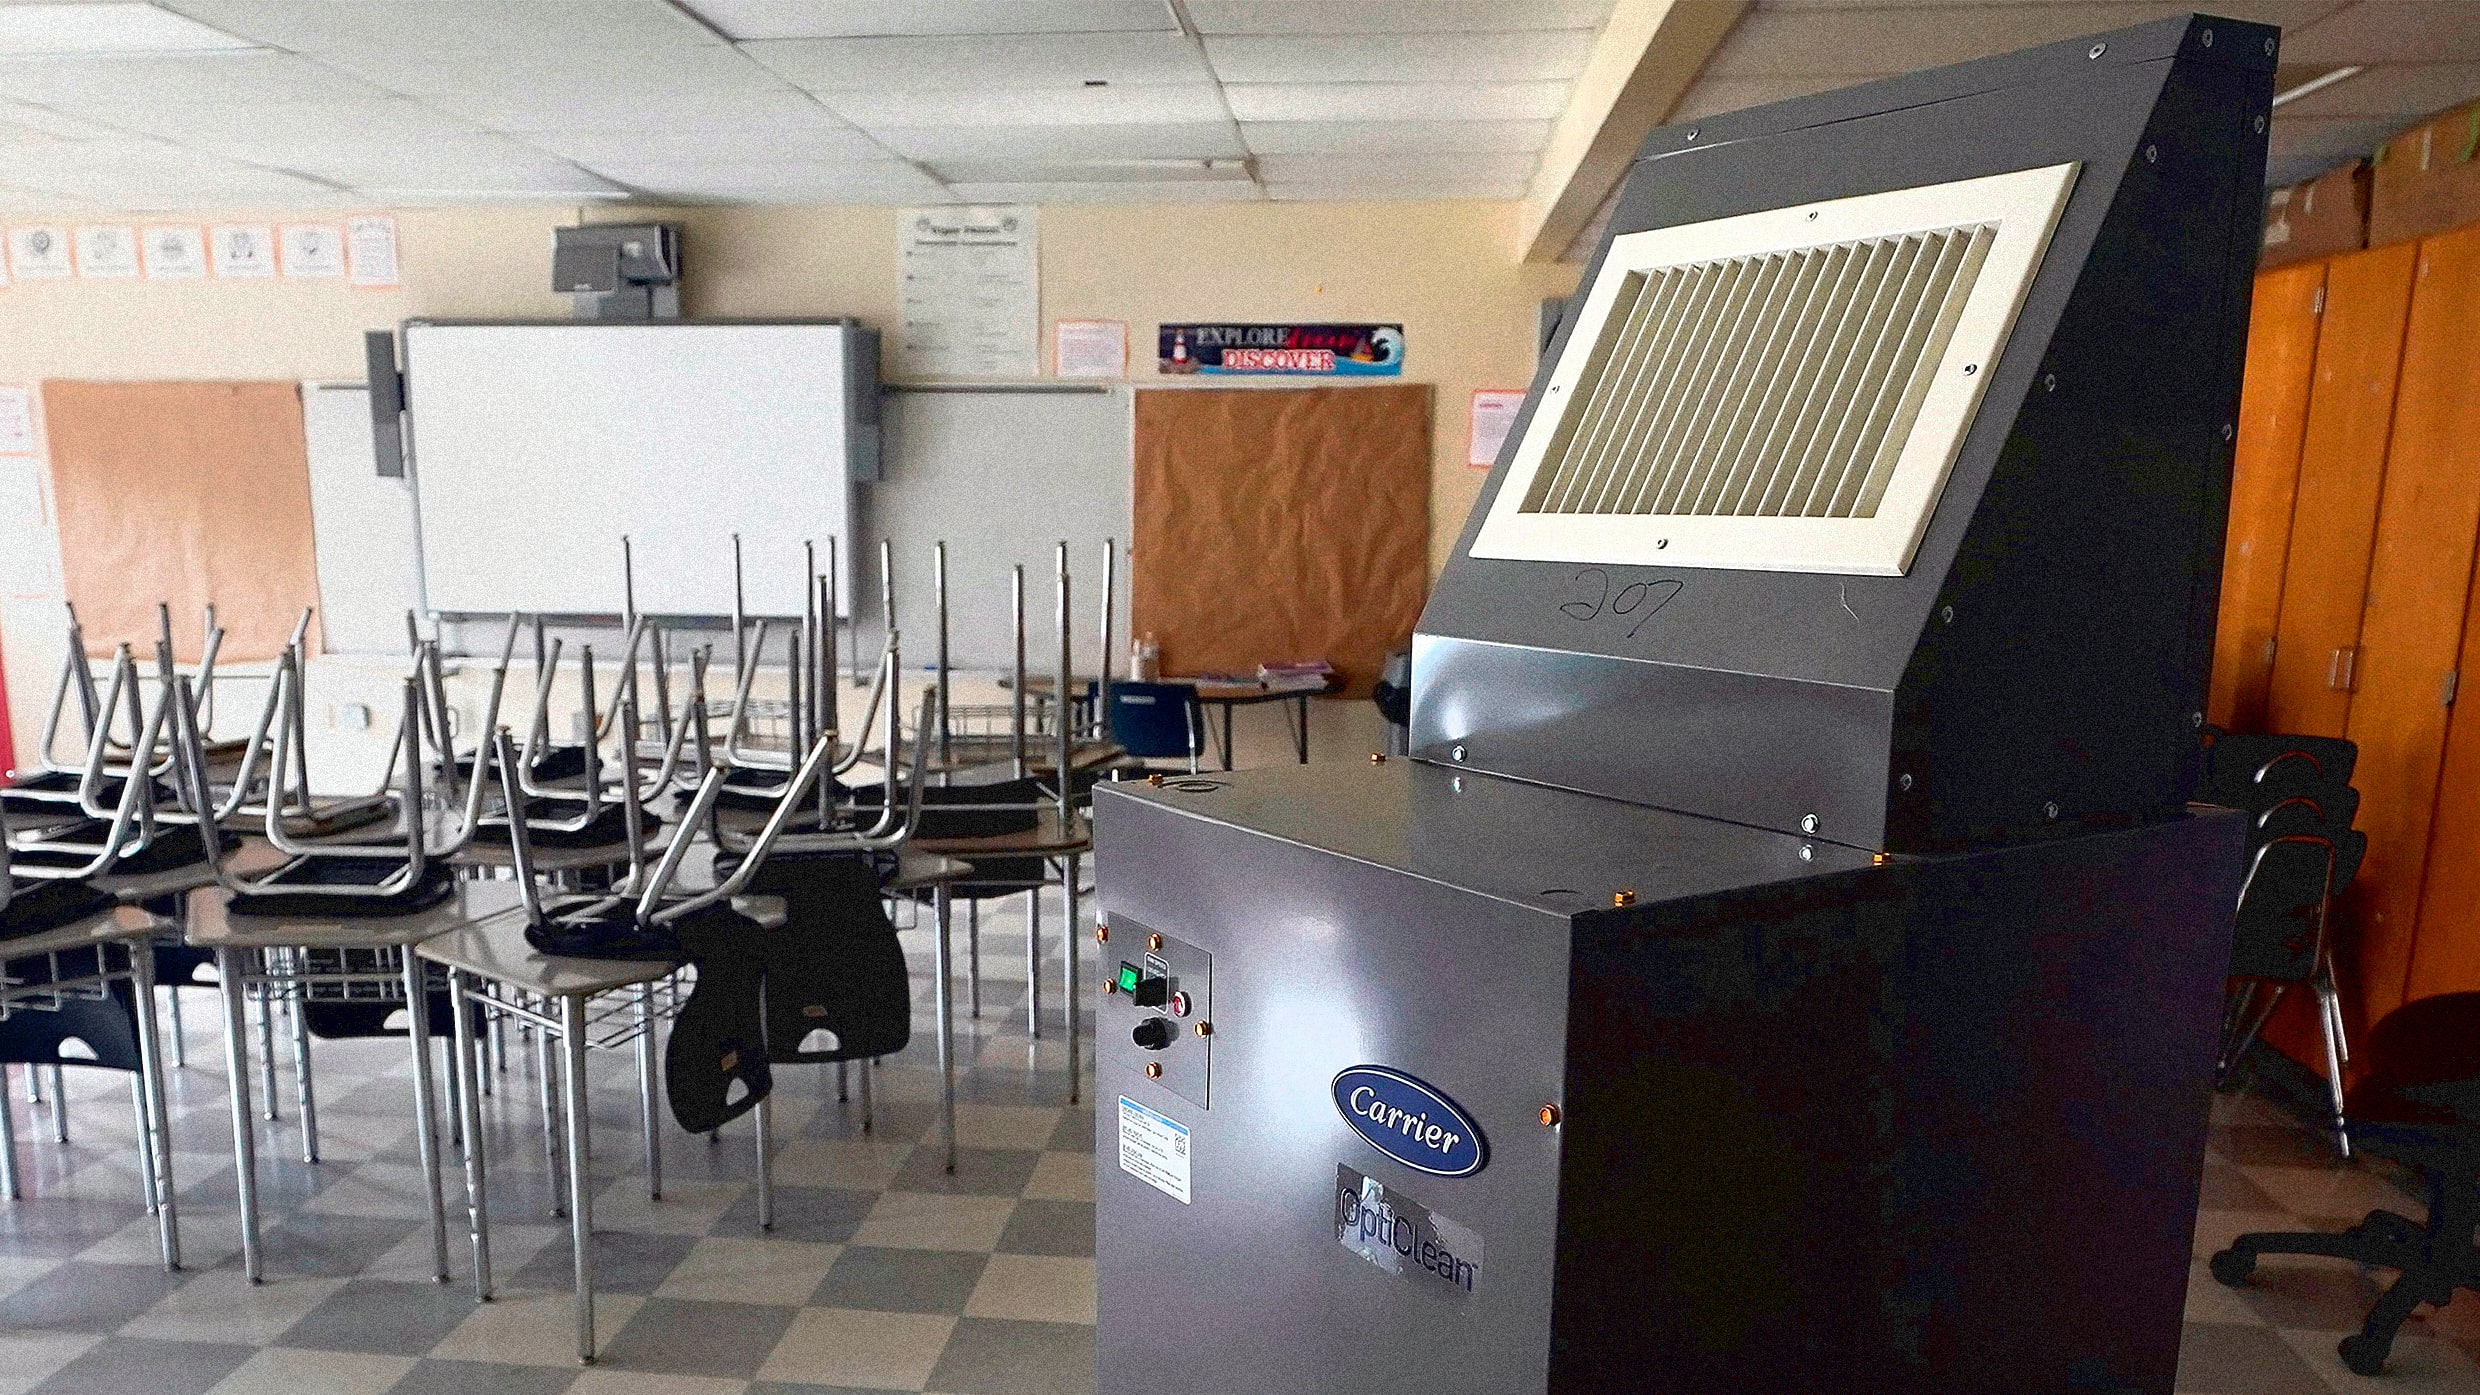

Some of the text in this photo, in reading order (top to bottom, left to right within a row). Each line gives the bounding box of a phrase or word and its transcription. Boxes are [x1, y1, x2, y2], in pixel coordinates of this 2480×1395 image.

[1196, 327, 1289, 346] EXPLORE
[1222, 350, 1336, 370] DISCOVER
[1559, 567, 1684, 639] 207
[1350, 1085, 1460, 1154] Carrier
[1341, 1187, 1474, 1293] OptiClean
